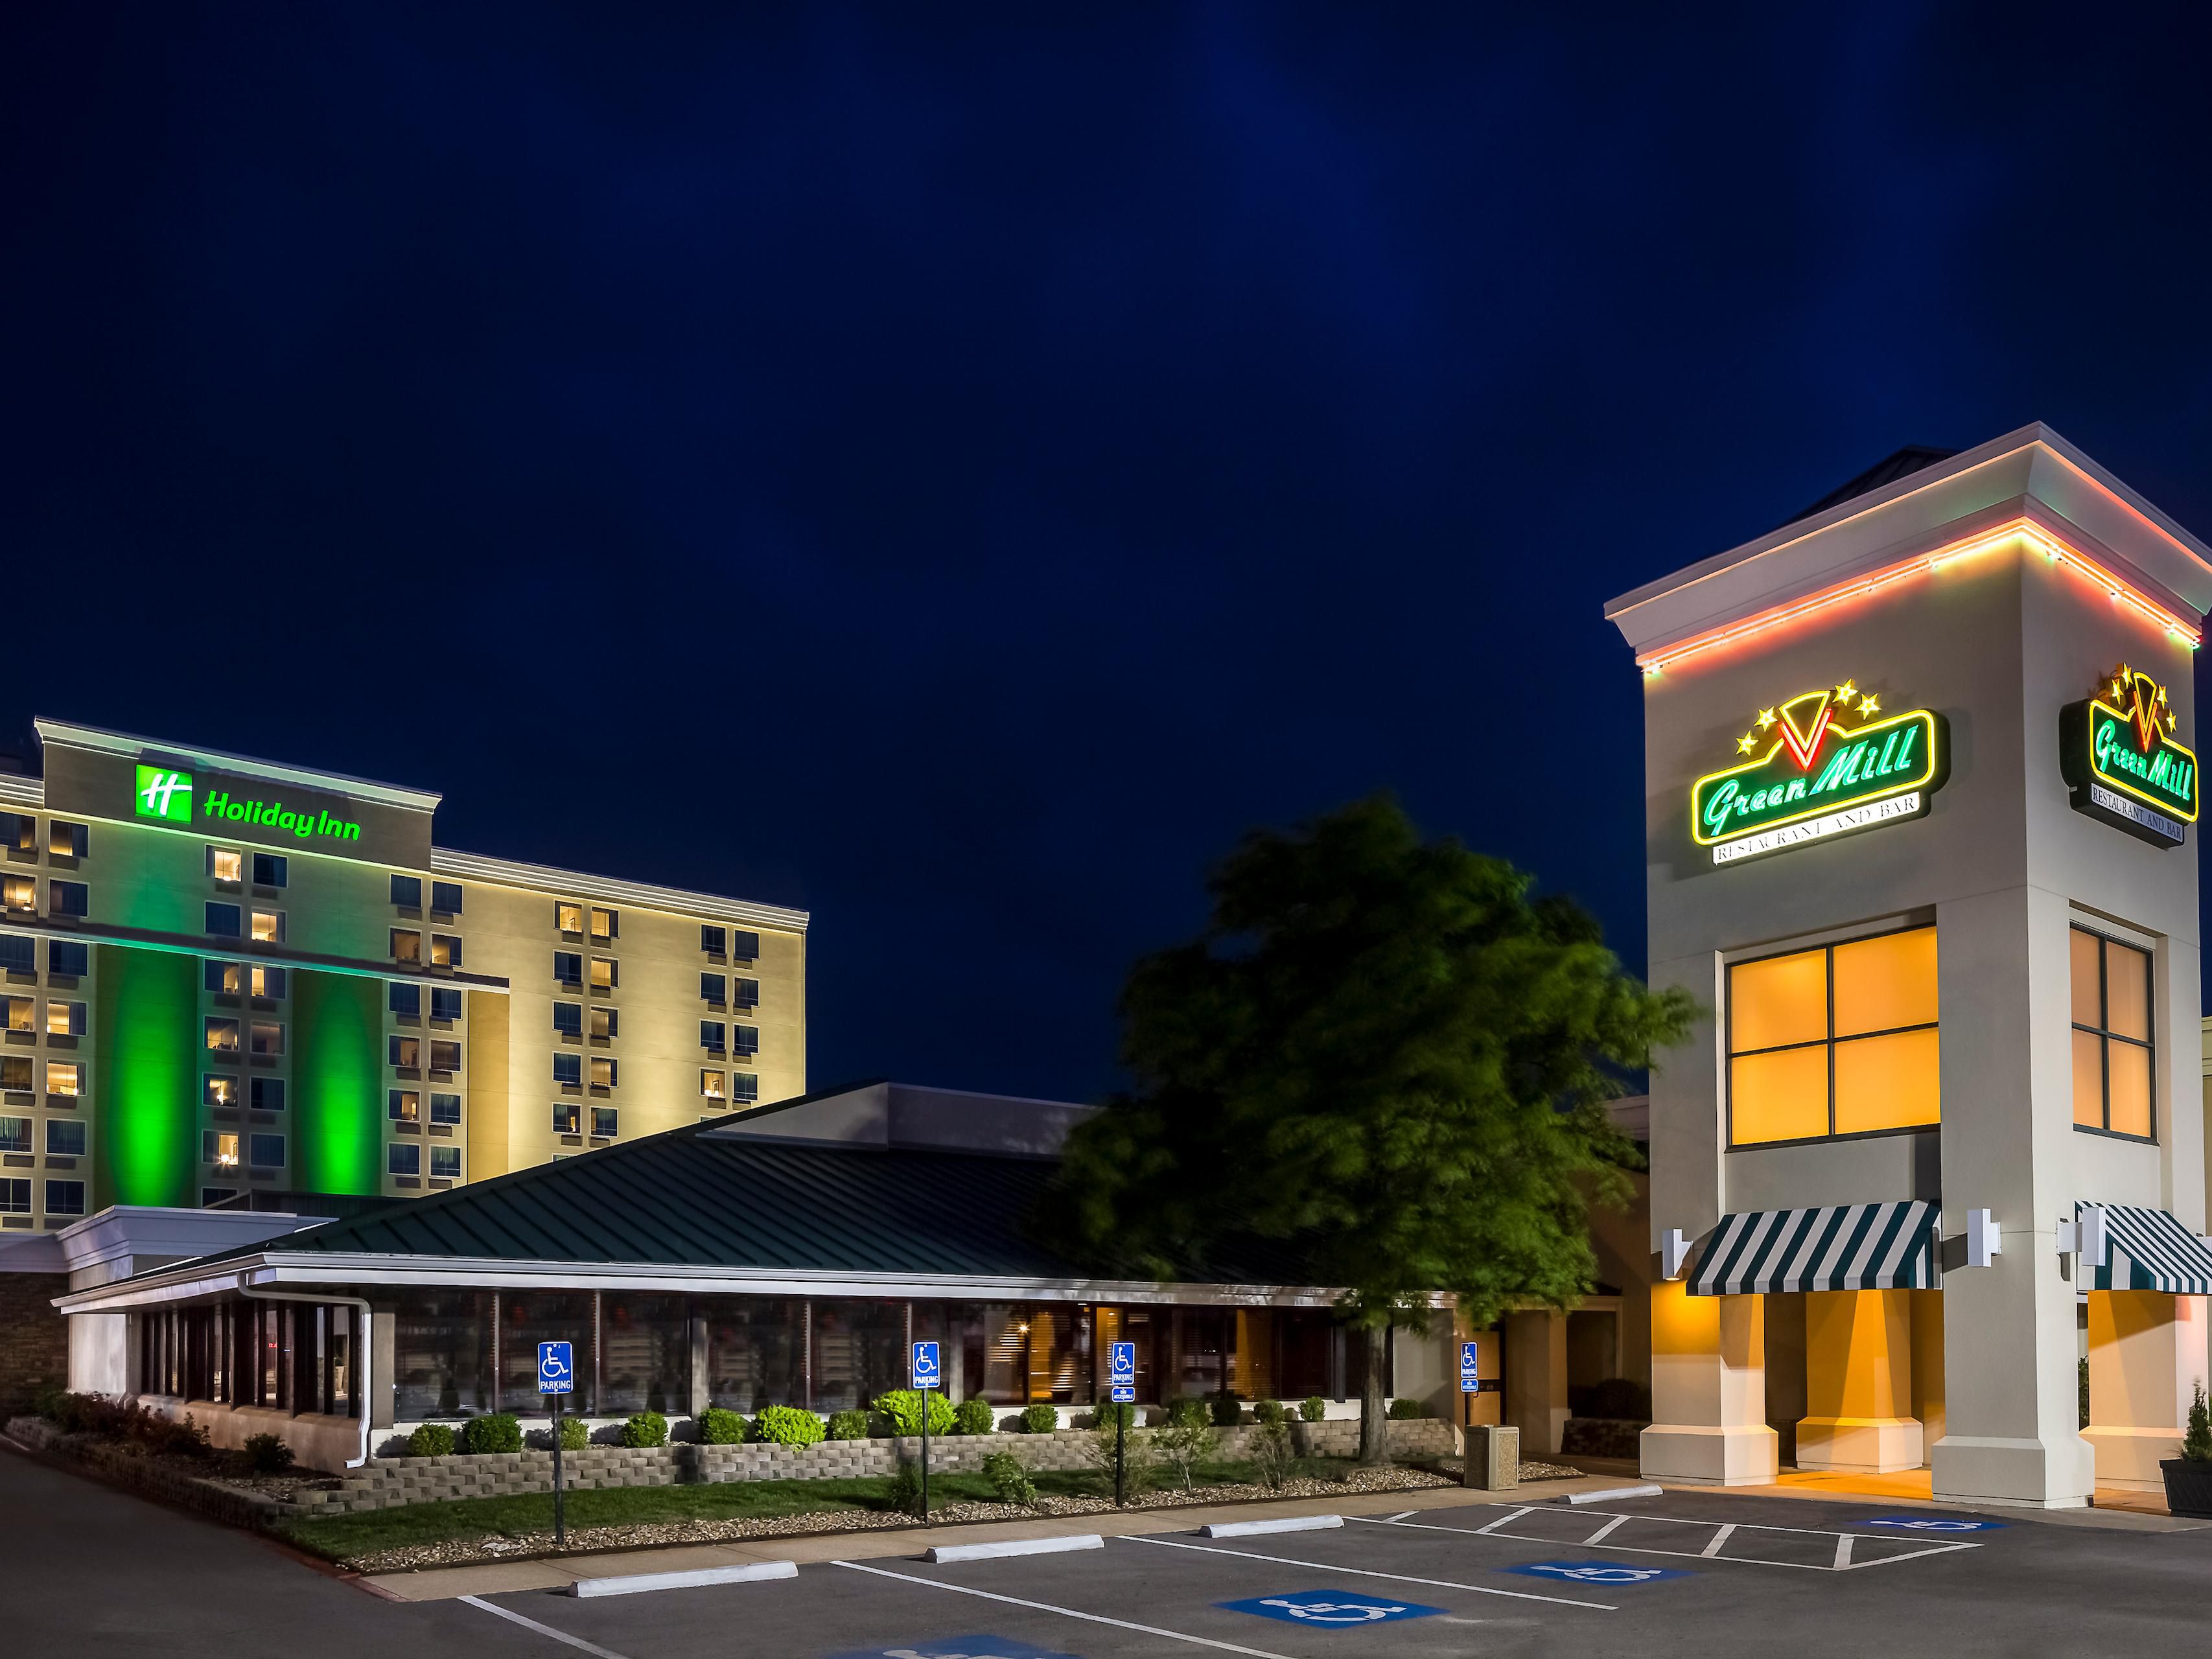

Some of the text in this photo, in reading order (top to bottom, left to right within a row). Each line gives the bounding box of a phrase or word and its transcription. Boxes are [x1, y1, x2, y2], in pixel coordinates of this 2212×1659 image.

[1704, 725, 1918, 836] Green Mill
[2096, 719, 2193, 801] Green Mill
[204, 790, 360, 841] Holiday Inn
[1718, 797, 1915, 860] RESTAURANT AND BAR
[2093, 786, 2182, 840] RESTAURANT AND BAR
[541, 1380, 570, 1389] PARKING
